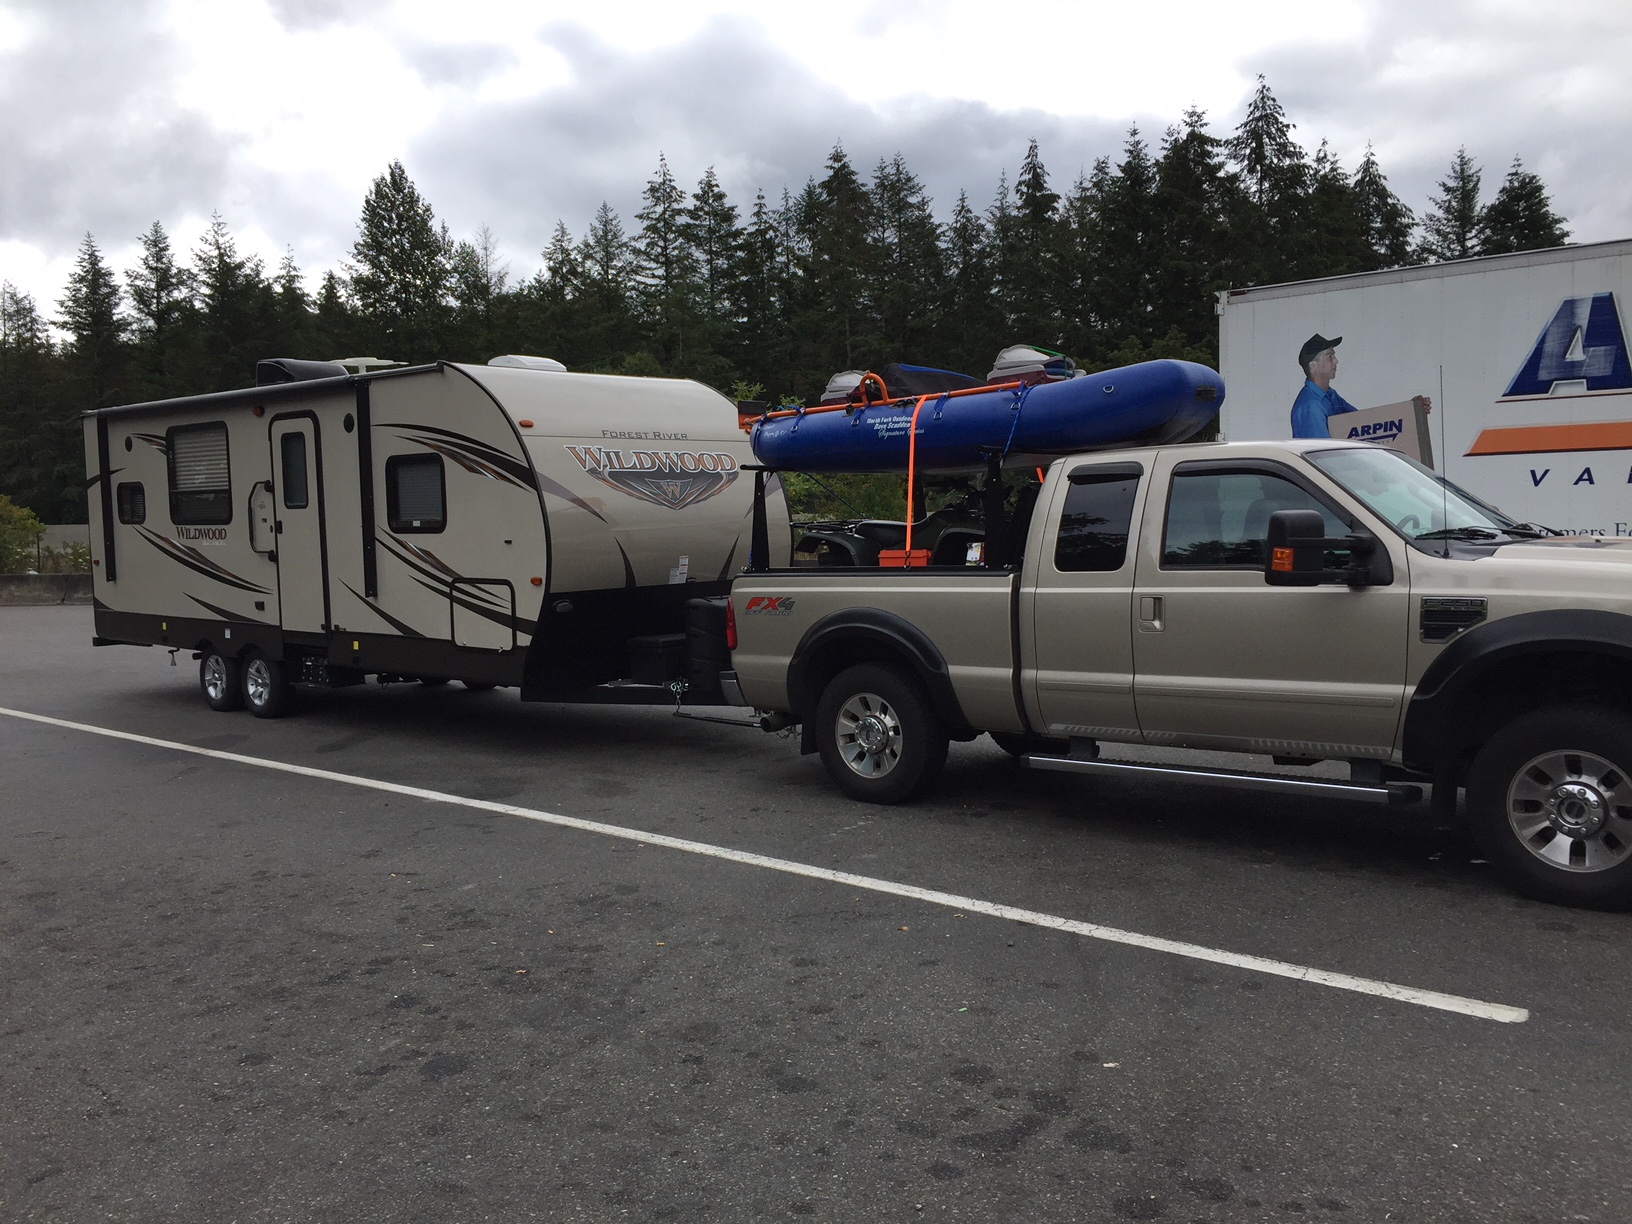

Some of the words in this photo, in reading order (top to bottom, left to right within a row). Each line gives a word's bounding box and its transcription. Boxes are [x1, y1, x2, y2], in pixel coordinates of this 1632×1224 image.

[601, 430, 649, 439] FOREST
[653, 431, 688, 440] RIVER
[1347, 419, 1403, 439] ARPIN
[564, 445, 738, 473] WILDWOOD
[176, 526, 227, 540] WILDWOOD
[745, 596, 796, 611] FX4
